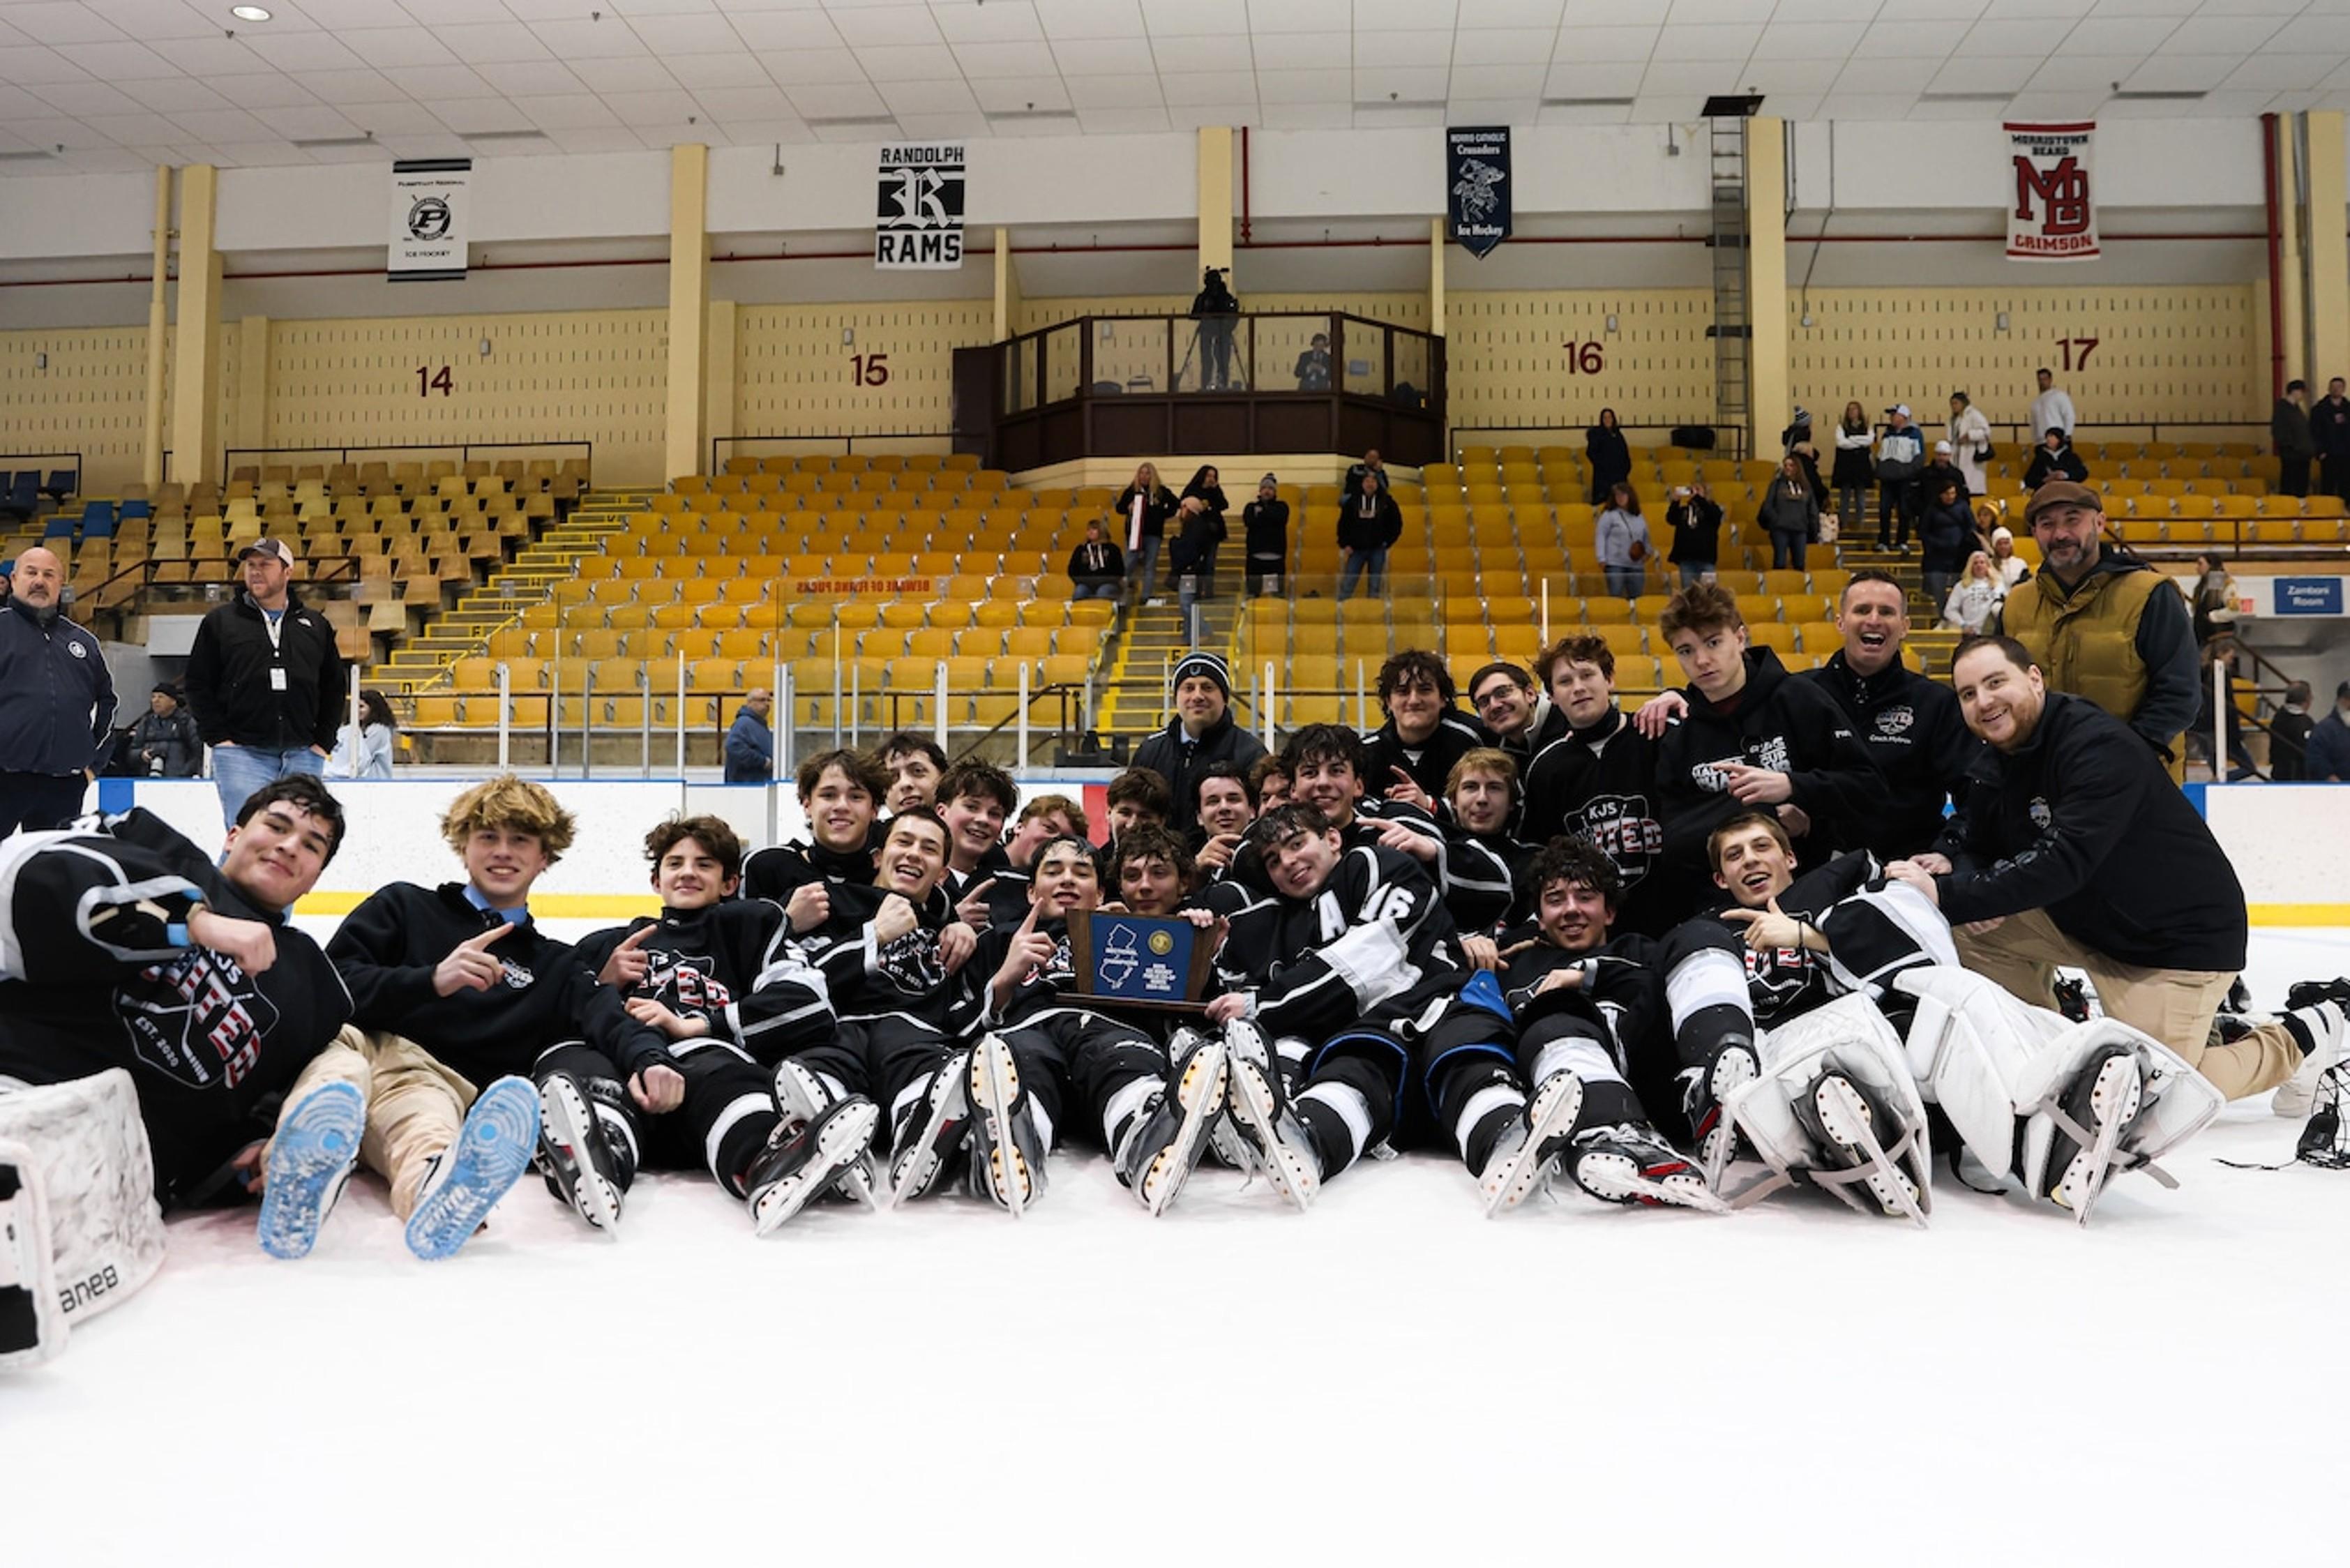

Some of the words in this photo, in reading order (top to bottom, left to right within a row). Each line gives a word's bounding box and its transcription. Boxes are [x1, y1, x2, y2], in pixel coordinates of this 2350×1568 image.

[881, 146, 965, 164] RANDOLPH
[1457, 144, 1500, 155] Crusaders
[878, 234, 961, 263] RAMS
[2015, 234, 2093, 250] CRIMSON
[850, 354, 888, 386] 15
[1562, 342, 1604, 375] 16
[2056, 338, 2099, 372] 17
[416, 366, 453, 397] 14
[2293, 596, 2324, 606] Room
[1589, 802, 1618, 820] KJS
[1318, 889, 1348, 942] A
[135, 1016, 158, 1039] EST.
[157, 1038, 179, 1068] 2020
